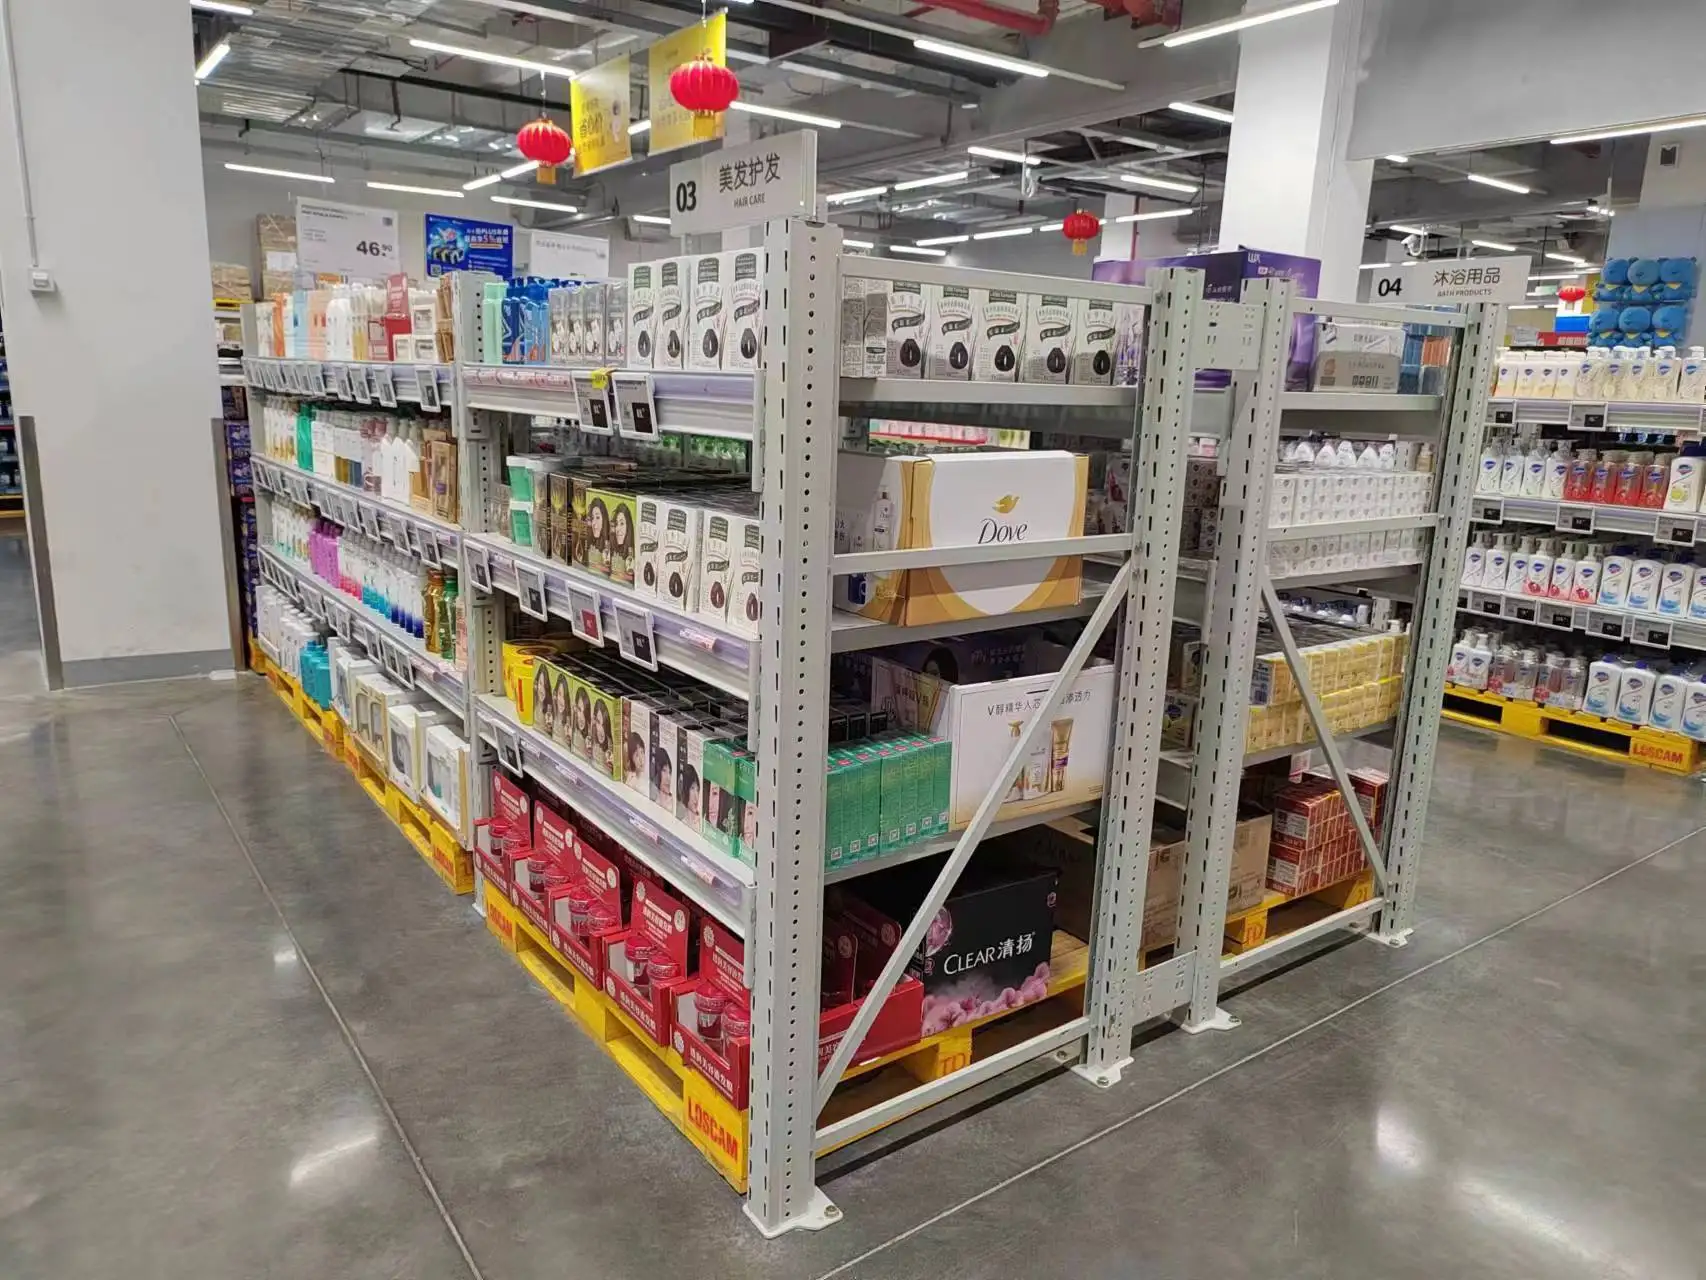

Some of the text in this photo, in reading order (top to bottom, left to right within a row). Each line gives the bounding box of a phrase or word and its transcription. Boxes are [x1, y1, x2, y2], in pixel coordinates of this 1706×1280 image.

[719, 152, 781, 193] 美发护发
[676, 180, 697, 213] 03
[733, 192, 766, 209] HAIR CARE
[1378, 277, 1403, 297] 04
[1433, 267, 1501, 287] 沐浴用品
[1437, 288, 1493, 298] BATH PRODUCTS
[978, 517, 1029, 545] Dove
[943, 933, 1033, 975] CLEAR 清扬
[687, 1096, 739, 1161] LOSCAM
